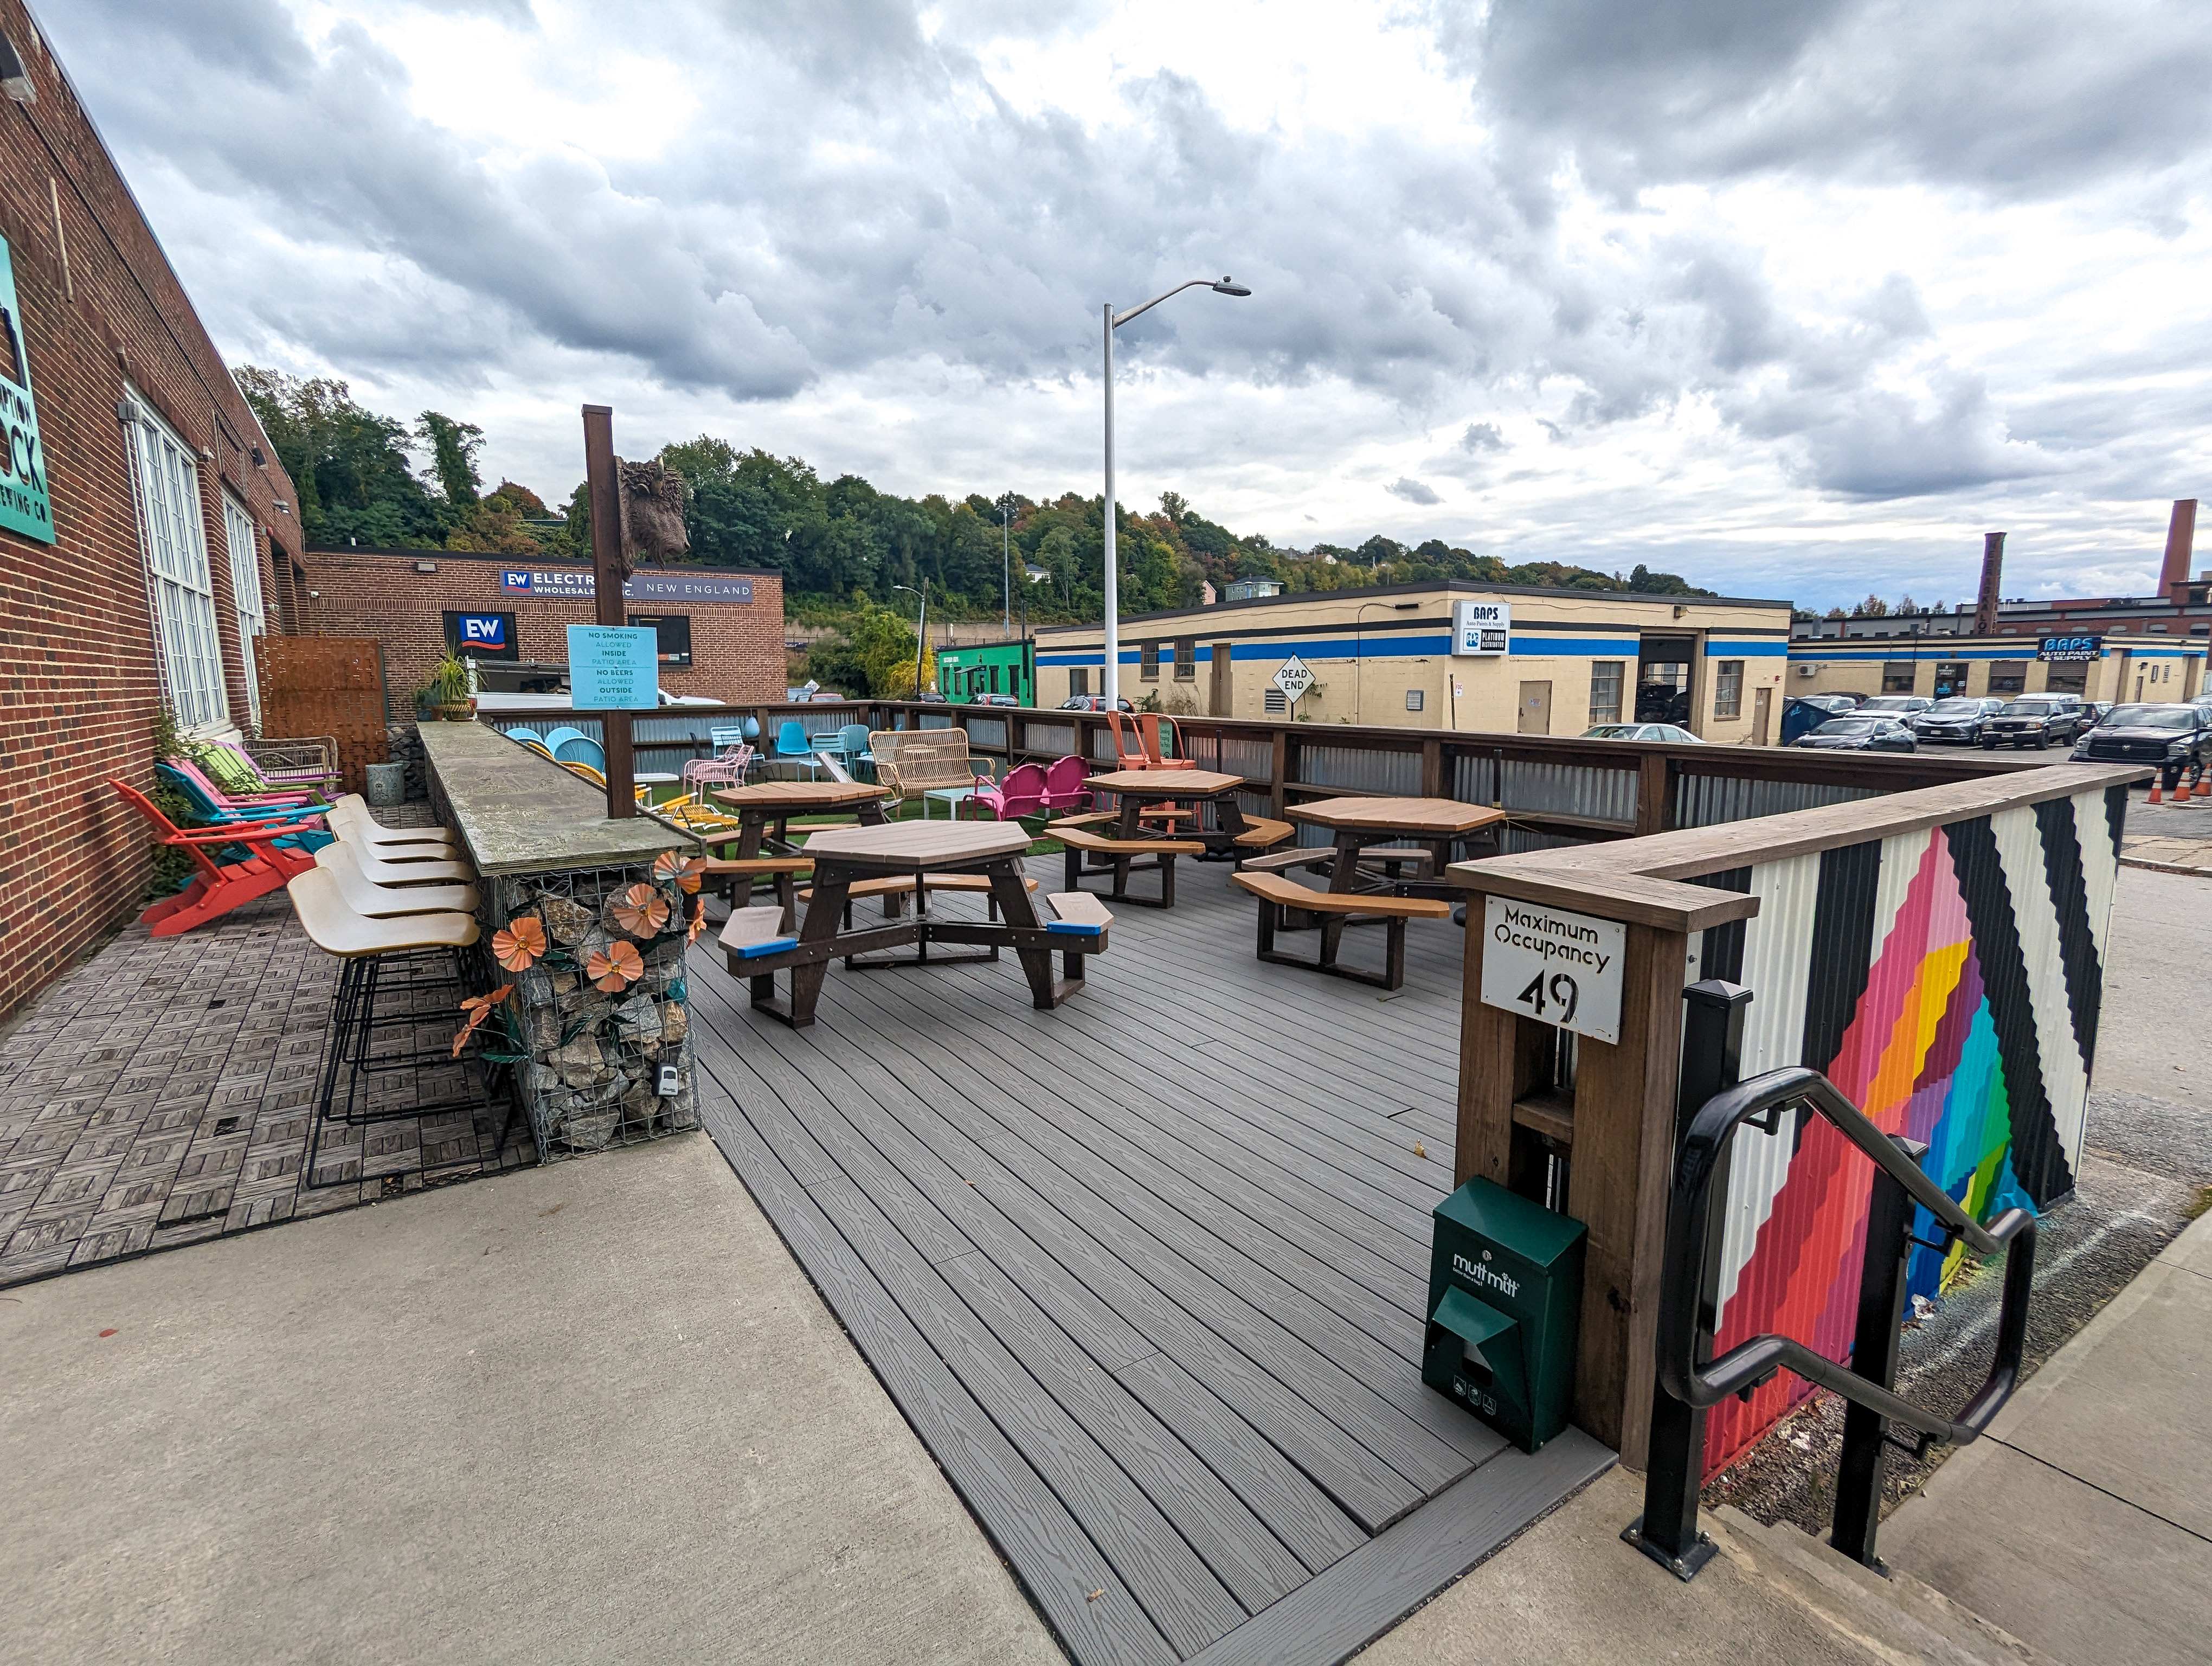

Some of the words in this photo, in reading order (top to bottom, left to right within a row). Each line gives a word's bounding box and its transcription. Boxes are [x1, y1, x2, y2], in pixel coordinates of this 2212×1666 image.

[507, 573, 527, 585] EW
[646, 583, 677, 593] NEW
[685, 585, 749, 595] ENGLAND
[1474, 606, 1499, 620] BAPS
[466, 619, 499, 638] EW
[1482, 632, 1505, 641] PLATINUM
[2044, 637, 2093, 651] BAPS
[1282, 669, 1307, 678] DEAD
[1285, 681, 1303, 689] END
[1504, 904, 1598, 944] Maximum
[1494, 924, 1611, 974] Occupancy
[1516, 969, 1579, 1023] 49
[1454, 1253, 1487, 1281] mutt
